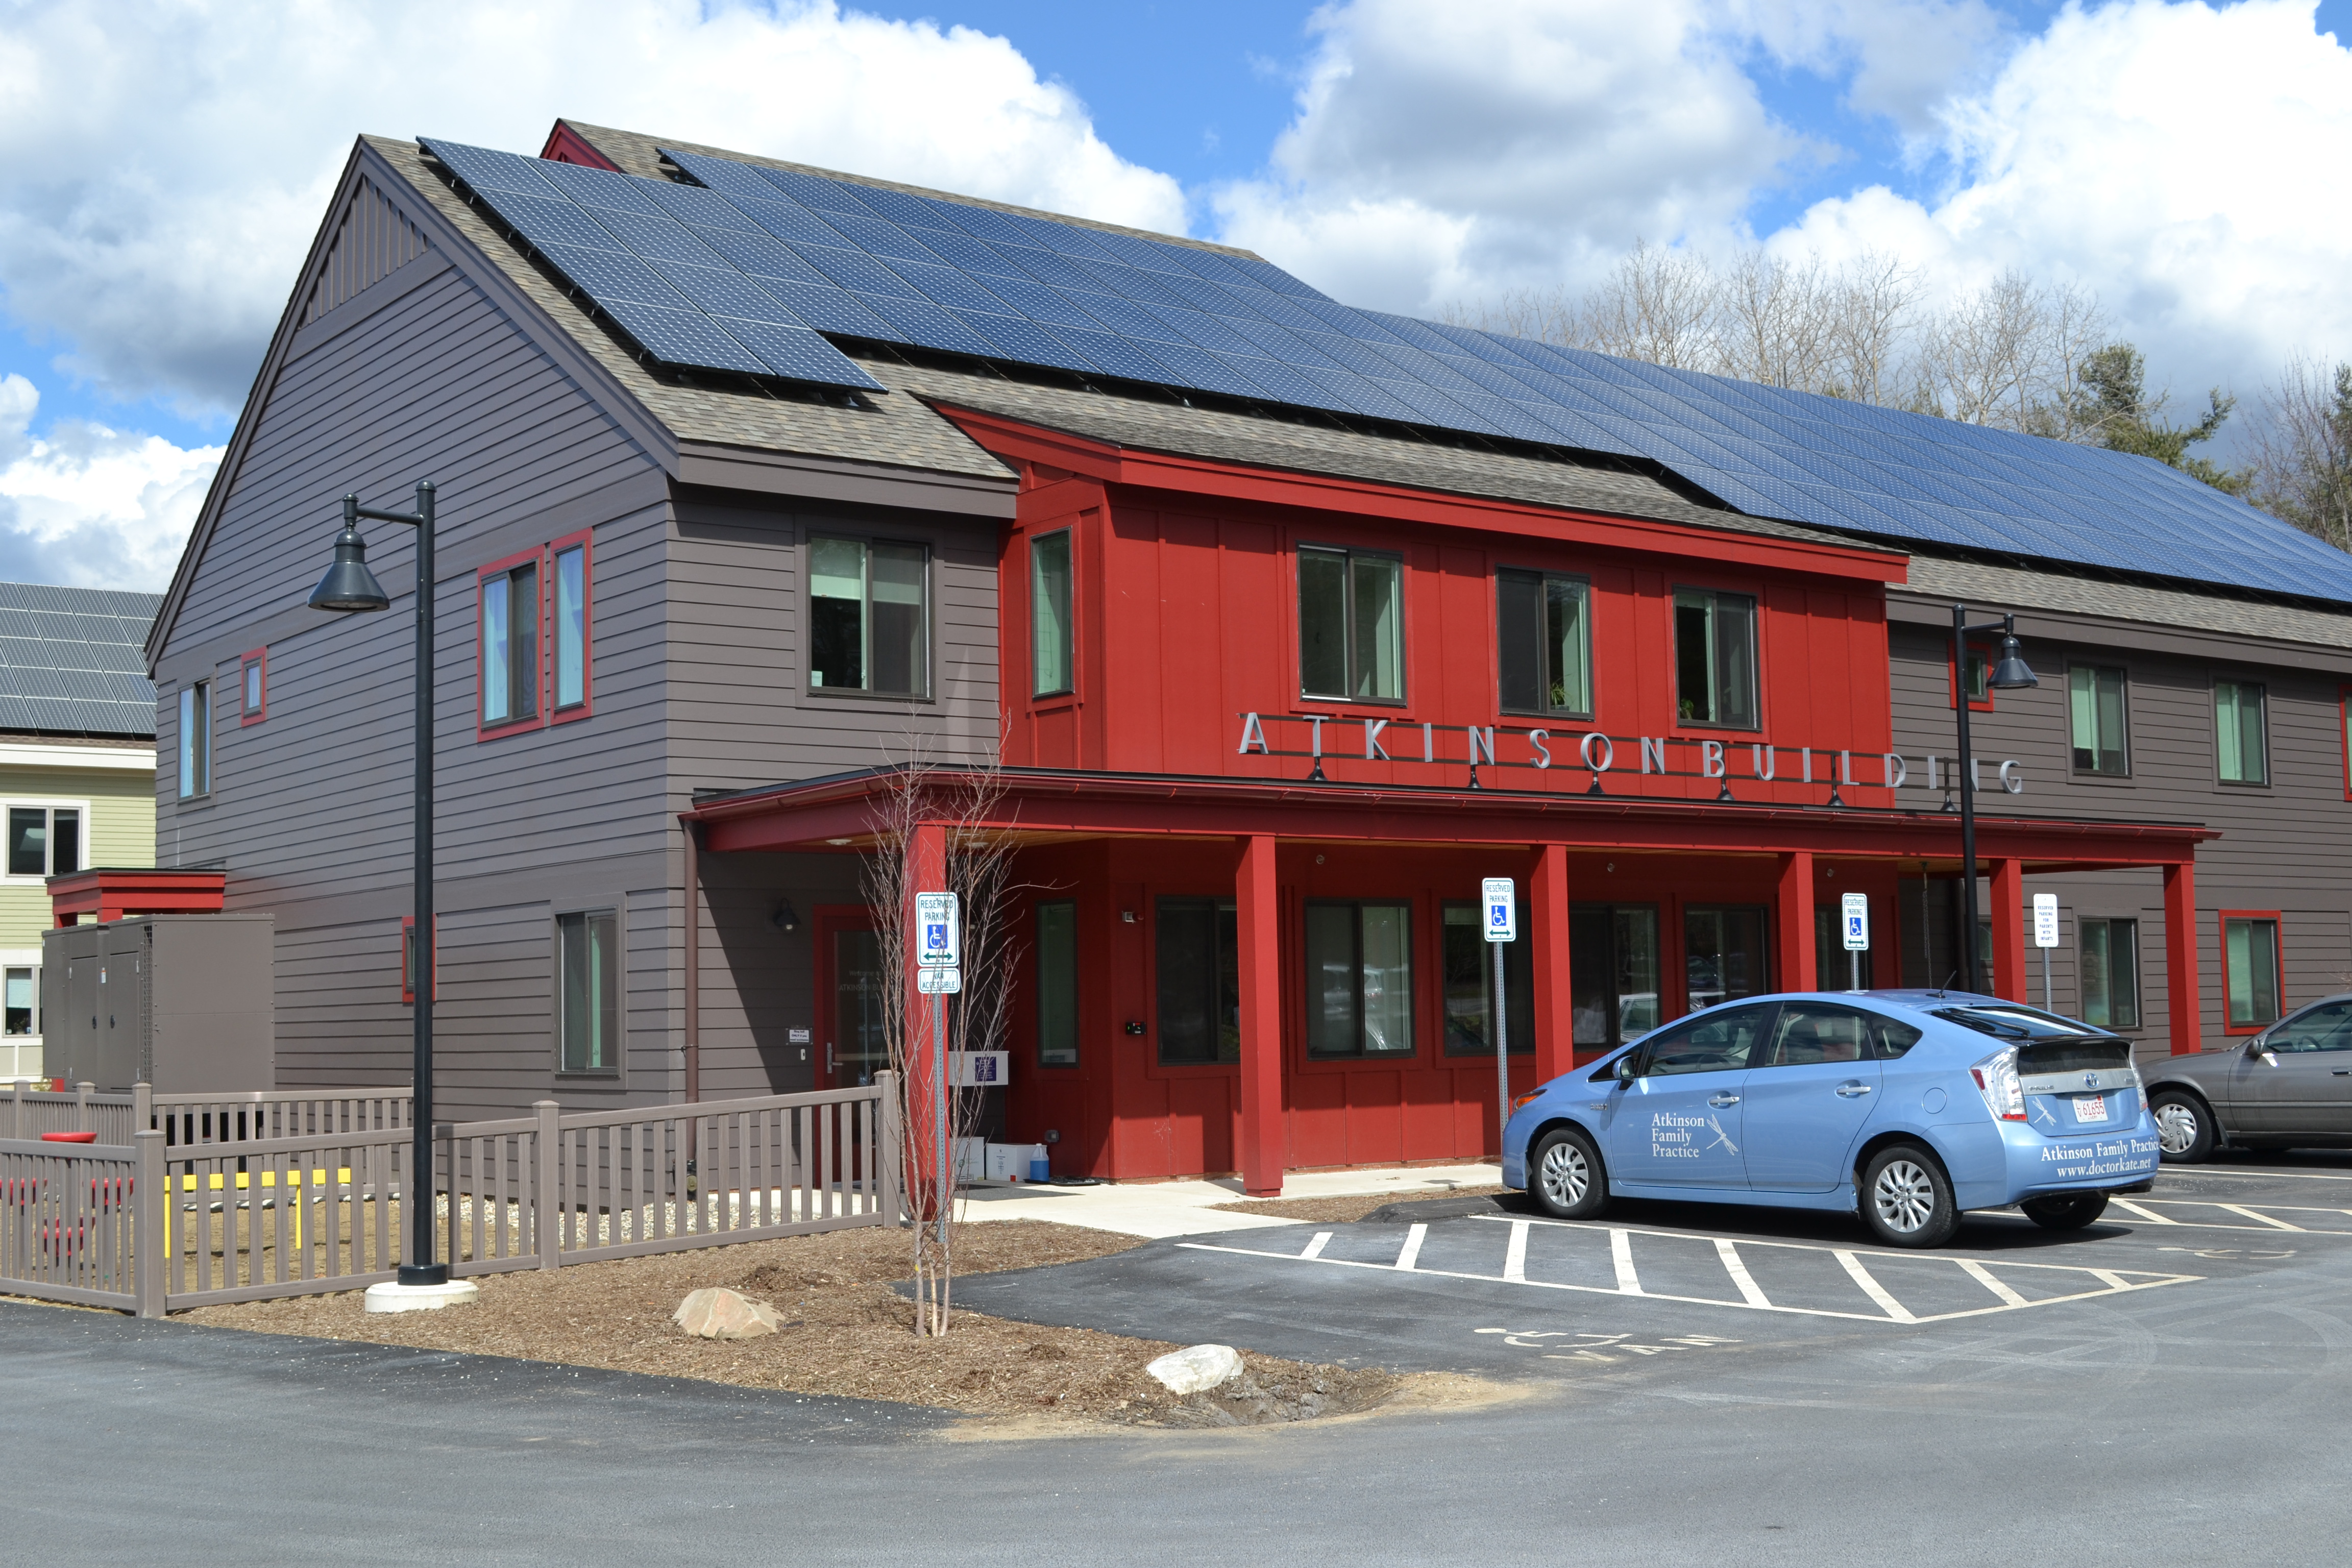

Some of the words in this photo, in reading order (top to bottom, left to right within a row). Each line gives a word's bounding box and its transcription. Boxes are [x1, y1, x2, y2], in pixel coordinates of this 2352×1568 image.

[1239, 712, 1664, 774] ATKINSON
[920, 900, 953, 909] RESERVED
[925, 912, 950, 921] PARKING
[922, 981, 955, 989] ACCESSIBLE
[2082, 1101, 2104, 1115] 61655
[1652, 1113, 1705, 1127] Atkinson
[1652, 1128, 1692, 1146] Family
[1652, 1144, 1699, 1158] Practice
[2041, 1145, 2093, 1161] Atkinson
[2096, 1140, 2128, 1157] Family
[2130, 1137, 2159, 1153] Practice
[2057, 1157, 2151, 1178] www.doctorkate.net
